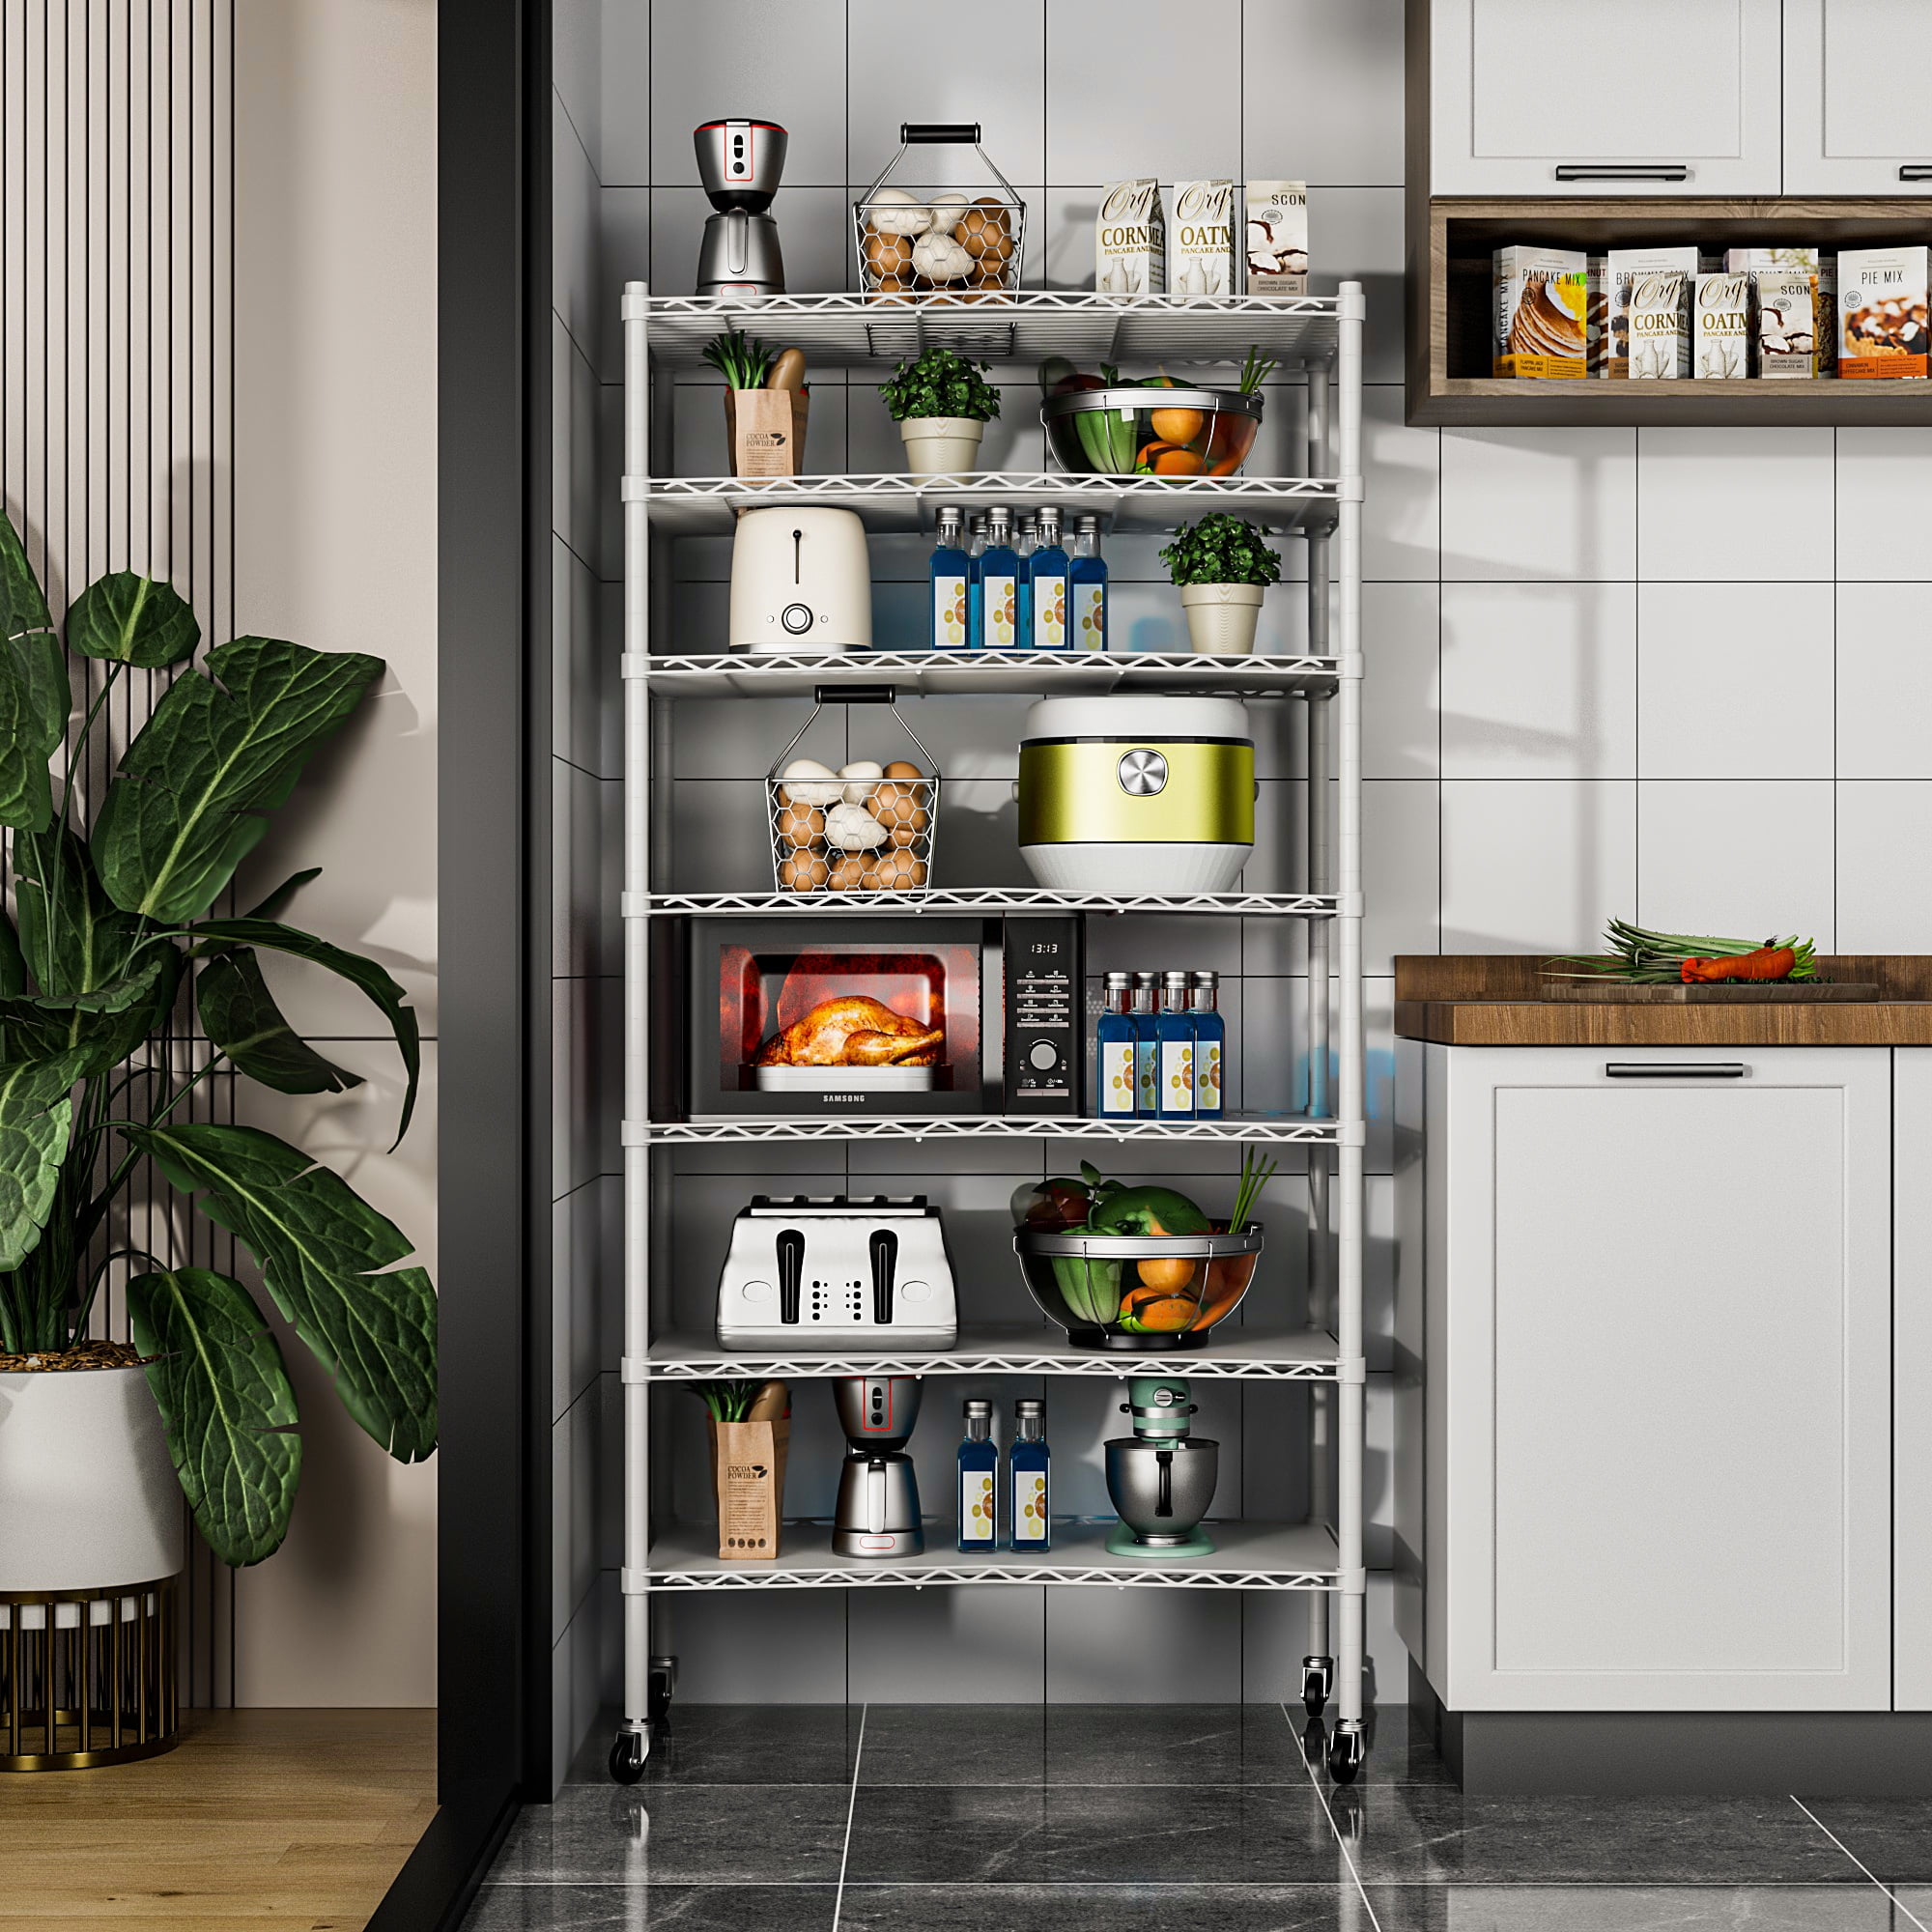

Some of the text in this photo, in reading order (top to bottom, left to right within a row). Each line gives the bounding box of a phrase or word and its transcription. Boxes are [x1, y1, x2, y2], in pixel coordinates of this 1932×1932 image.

[1271, 194, 1305, 206] SCON
[1522, 269, 1581, 287] PANCAKE MIX
[1861, 270, 1903, 285] PIE MIX
[1780, 285, 1810, 296] SCON
[1031, 944, 1058, 953] 13:13
